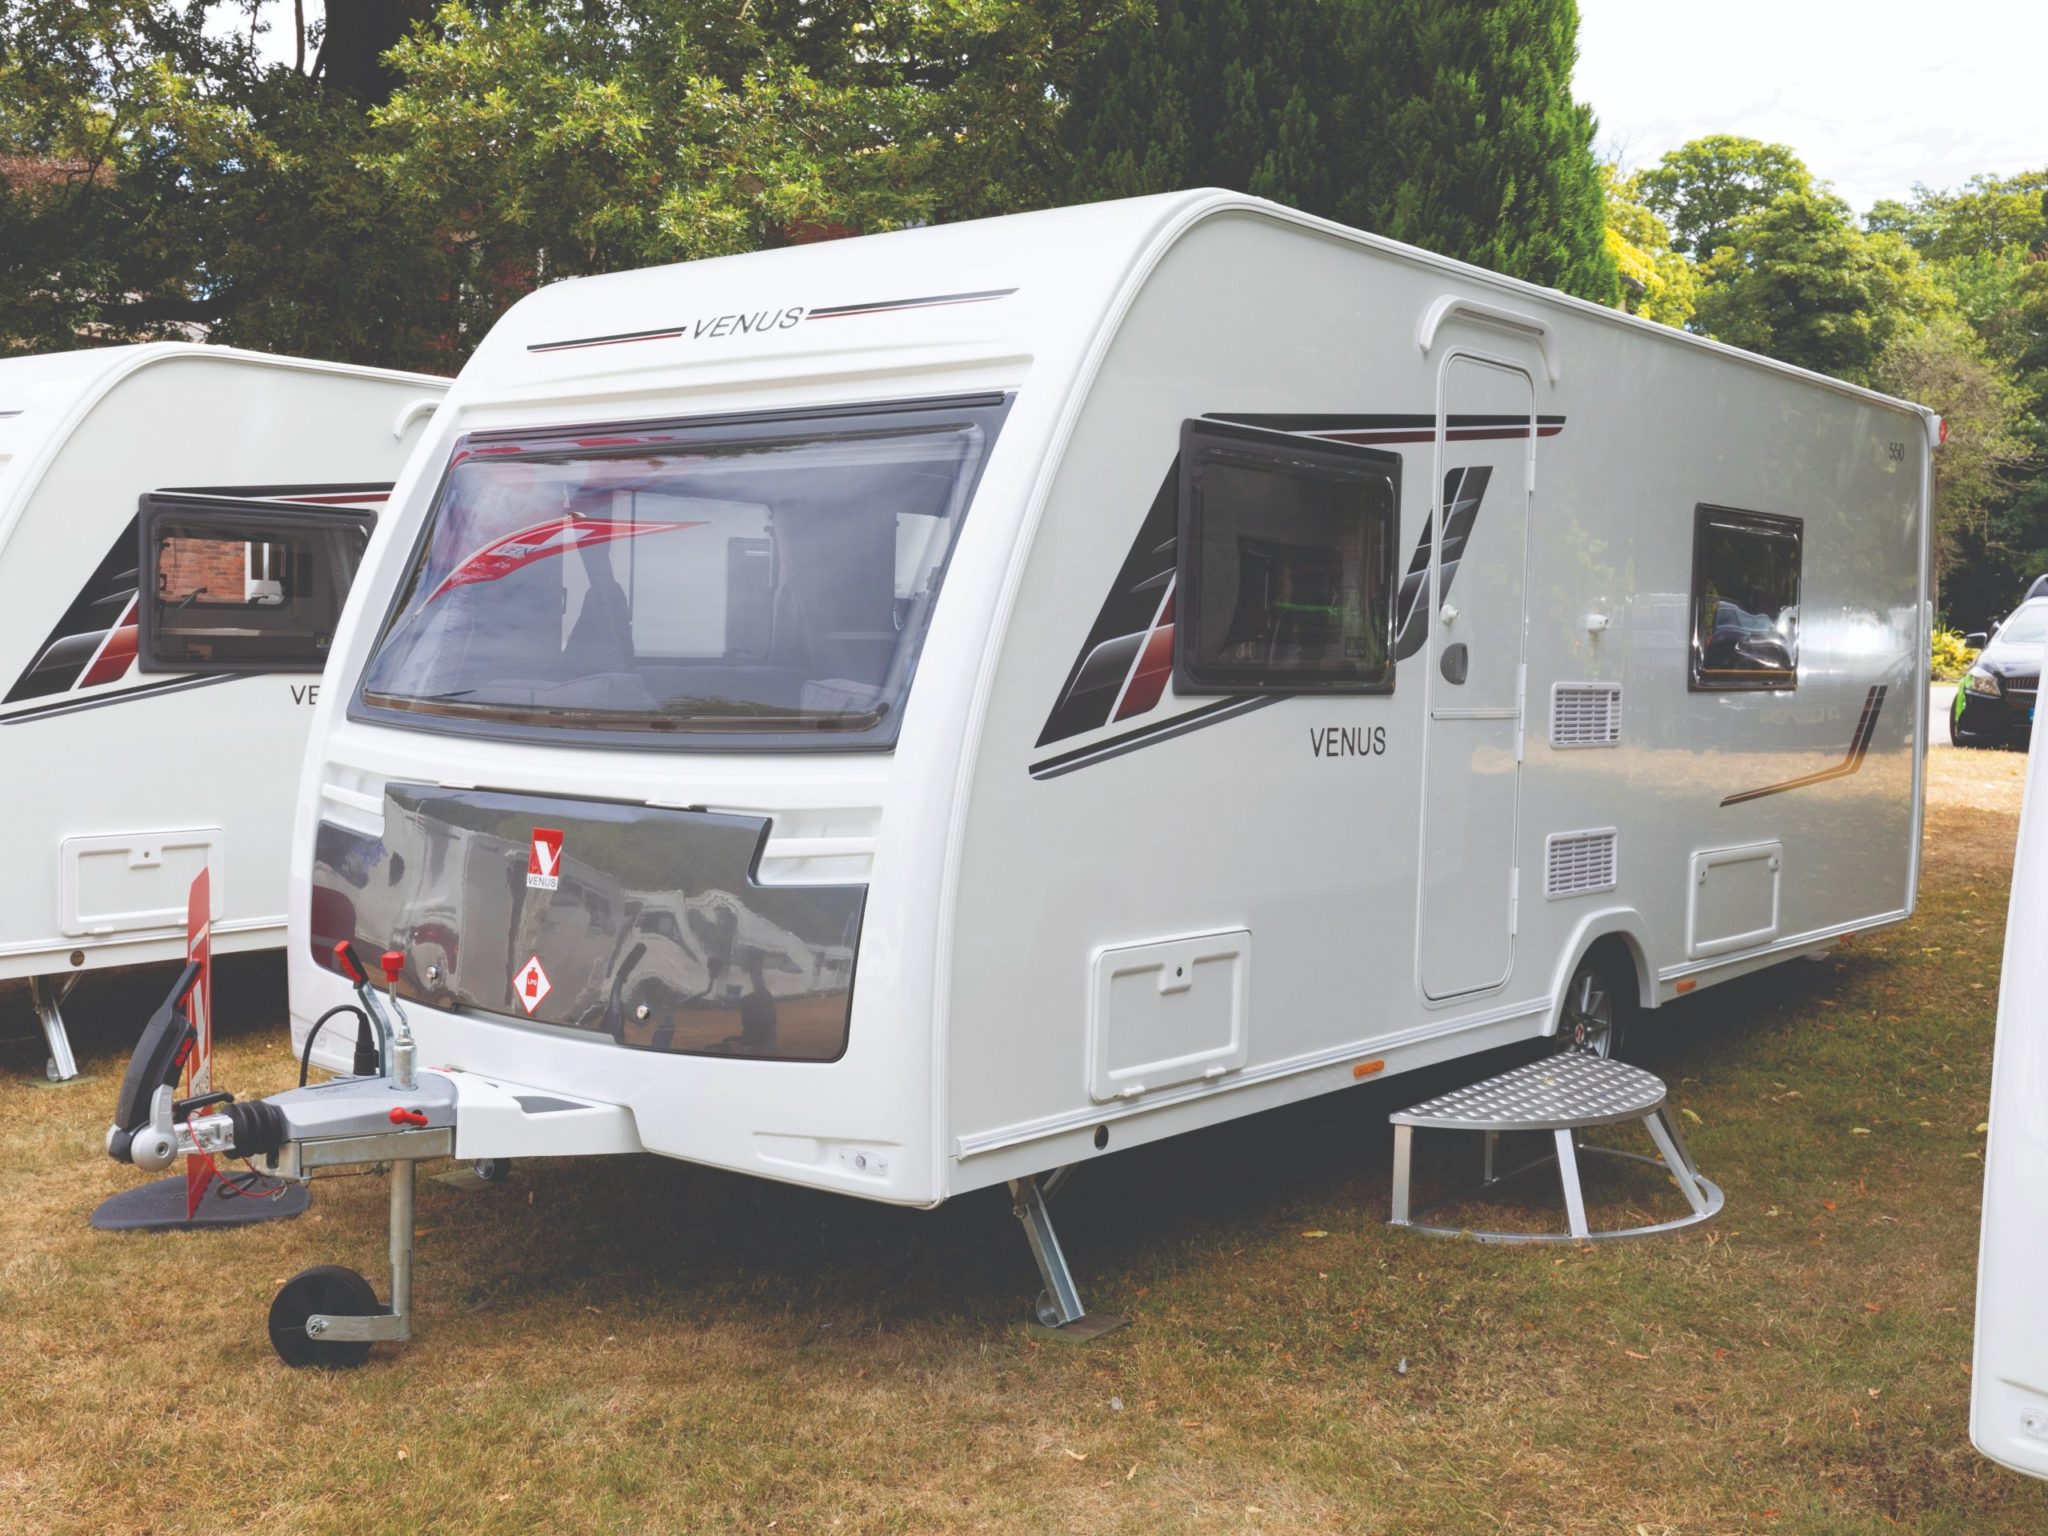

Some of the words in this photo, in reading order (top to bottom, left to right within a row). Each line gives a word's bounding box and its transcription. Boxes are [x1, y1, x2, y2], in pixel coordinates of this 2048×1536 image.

[692, 306, 806, 340] VENUS
[1889, 442, 1905, 462] 550
[290, 684, 321, 706] VE
[1310, 726, 1386, 758] VENUS
[527, 876, 558, 888] VENUS
[527, 978, 538, 986] LPG
